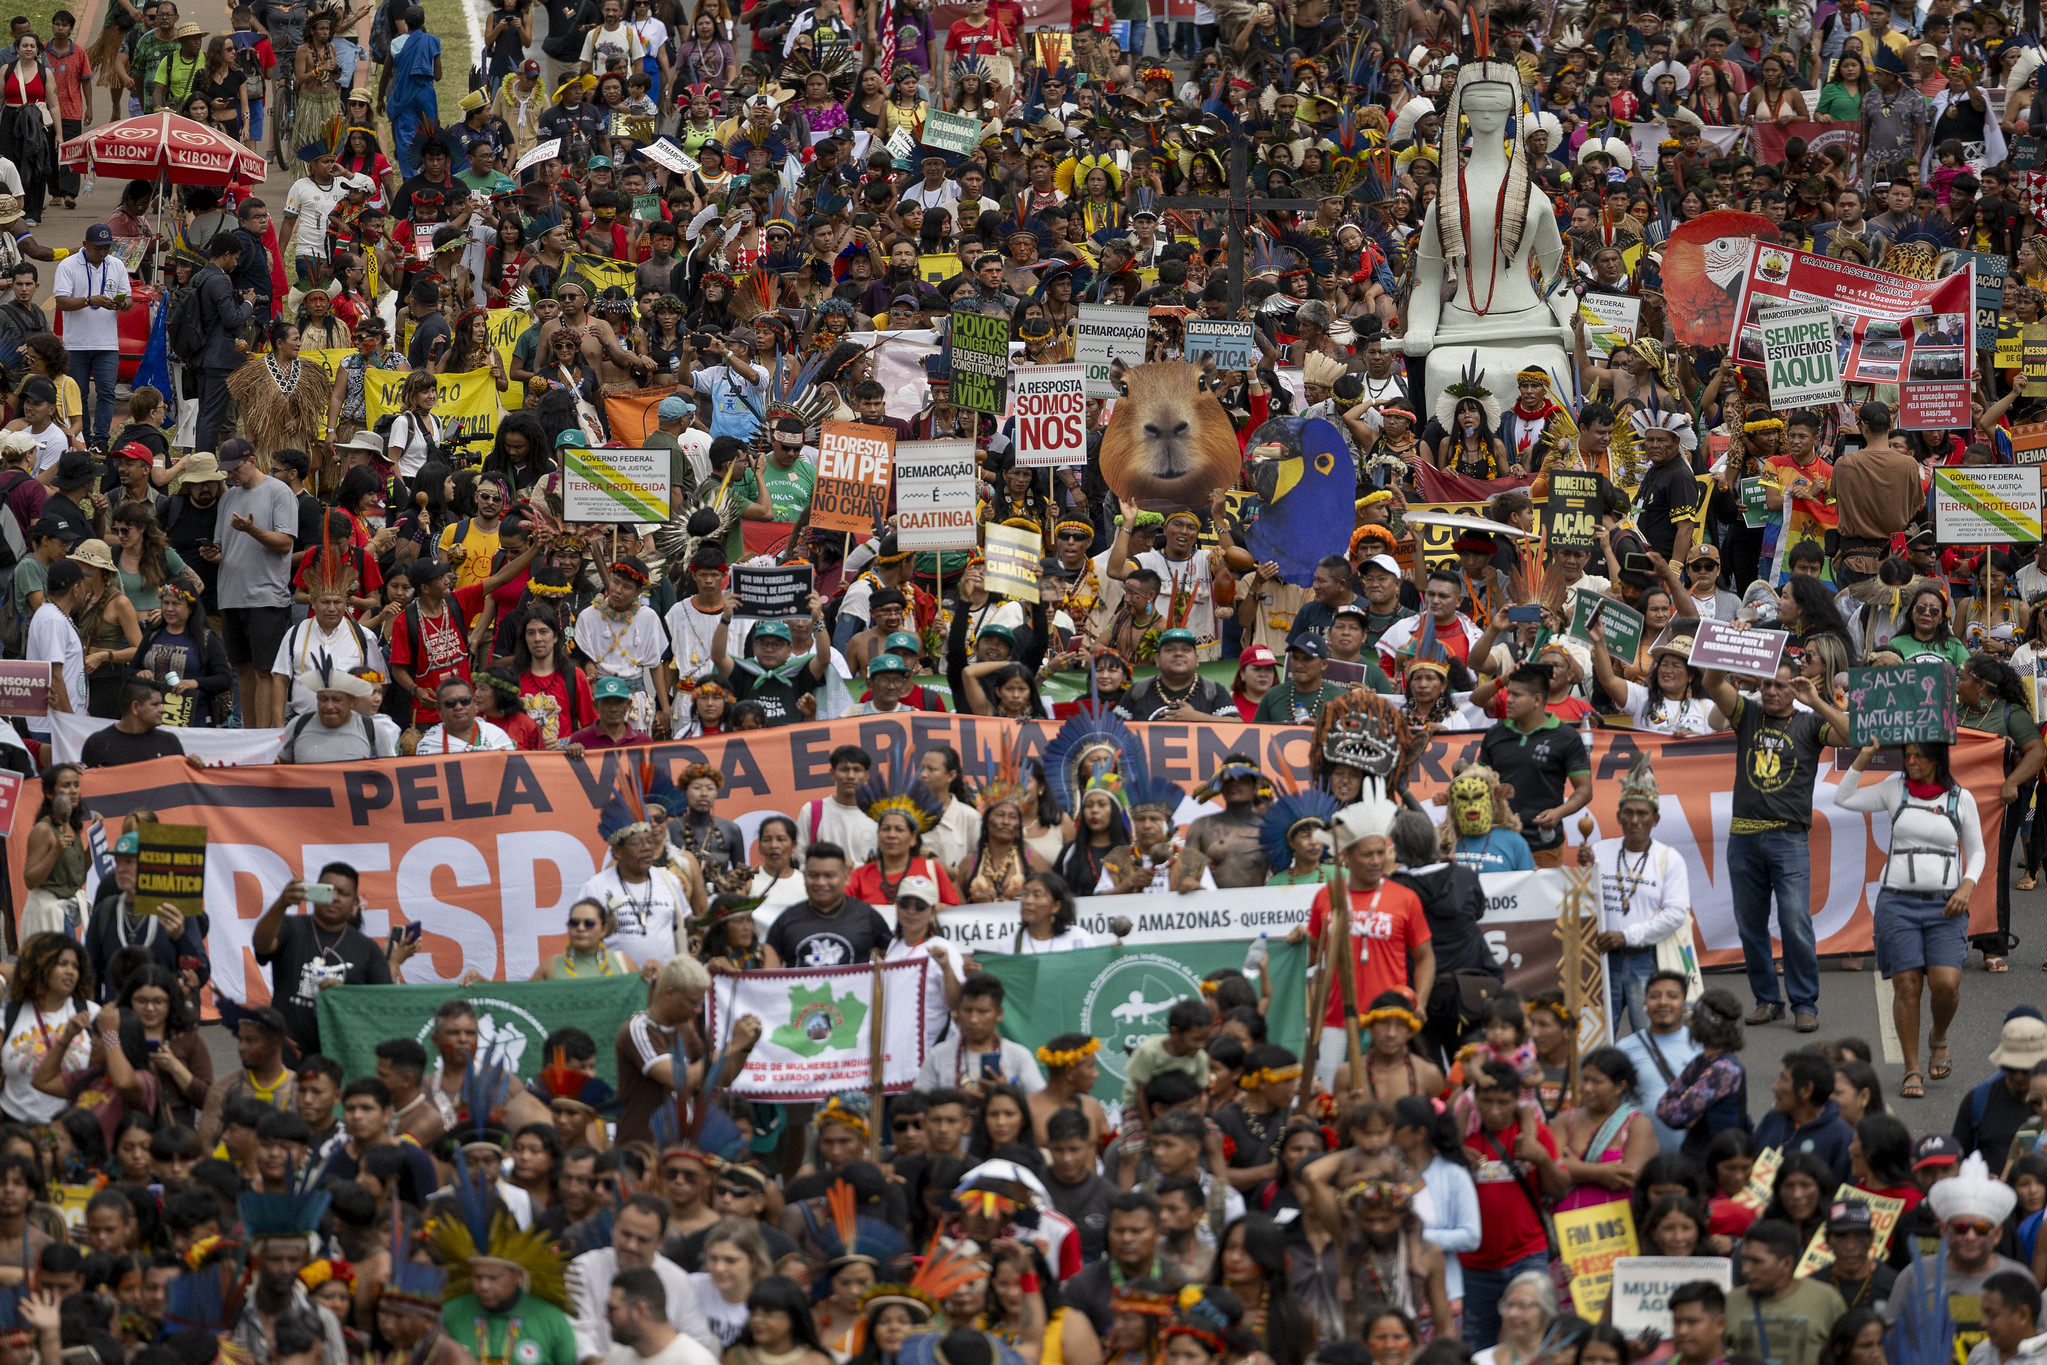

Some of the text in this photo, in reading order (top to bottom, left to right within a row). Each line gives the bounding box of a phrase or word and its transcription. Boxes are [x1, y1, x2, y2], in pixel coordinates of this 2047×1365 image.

[934, 112, 974, 128] DEFENDER
[931, 120, 974, 137] OS BIOMAS
[933, 130, 974, 145] DEFENDER
[936, 138, 962, 152] A VIDA
[105, 144, 147, 158] KIBON
[178, 150, 221, 166] KIBON
[656, 142, 700, 170] DEMARCAÇÃO
[1800, 255, 1919, 290] GRANDE ASSEMBLEIA DO
[1836, 284, 1847, 293] 08
[1856, 288, 1867, 298] 14
[1869, 291, 1910, 306] Dezembro
[1875, 284, 1912, 298] KAIOWÁ
[1596, 299, 1626, 308] FEDERAL
[1602, 308, 1623, 316] JUSTIÇA
[1760, 304, 1829, 320] #MARCOTEMPORALNÃO
[953, 313, 1008, 342] POVOS
[1079, 324, 1146, 341] DEMARCAÇÃO
[1189, 322, 1250, 337] DEMARCAÇÃO
[1765, 321, 1830, 347] SEMPRE
[1215, 336, 1221, 348] É
[1768, 340, 1832, 360] ESTIVEMOS
[952, 348, 1006, 367] EM DEFESA DA
[1106, 344, 1114, 358] É
[951, 358, 1006, 378] CONSTITUIÇÃO
[1772, 354, 1834, 389] AQUI
[966, 373, 988, 388] E DA
[1018, 379, 1082, 394] A RESPOSTA
[958, 383, 995, 411] VIDA
[1016, 392, 1084, 416] SOMOS
[1772, 390, 1840, 406] #MARCOTEMPORALNÃO
[1920, 392, 1944, 401] EDUCAÇÃO
[1920, 400, 1947, 409] EFETIVAÇÃO
[1020, 410, 1082, 451] NÓS
[823, 433, 889, 458] FLORESTA
[818, 451, 890, 485] EM PÉ
[898, 462, 973, 479] DEMARCAÇÃO
[568, 482, 666, 491] TERRA PROTEGIDA
[1554, 476, 1596, 490] DIREITOS
[932, 487, 940, 502] É
[813, 494, 837, 512] NO
[1939, 502, 2037, 511] TERRA PROTEGIDA
[900, 511, 973, 528] CAATINGA
[1552, 511, 1595, 538] AÇÃO
[1551, 536, 1594, 546] CLIMÁTICA
[987, 543, 1013, 556] ACESSO
[1015, 549, 1038, 563] DIRETO
[740, 574, 793, 584] POR UM CONSELHO
[741, 584, 768, 594] NACIONAL
[778, 582, 807, 594] EDUCAÇÃO
[1581, 596, 1640, 629] POR NACIONAL
[1614, 621, 1634, 636] ESCOLAR
[1710, 625, 1724, 634] POR
[1715, 634, 1757, 647] QUE RESPEITE
[1702, 641, 1774, 659] DIVERSIDADE CULTURAL!
[1862, 668, 1917, 690] SALVE
[4, 687, 31, 697] VIDA
[1886, 691, 1896, 707] A
[1857, 708, 1940, 729] NATUREZA
[1857, 725, 1940, 744] URGENTE
[344, 754, 553, 826] PELA
[789, 726, 838, 791] E
[859, 717, 1057, 779] PELA
[139, 851, 204, 865] ACESSO DIRETO
[138, 871, 203, 892] CLIMÁTICO
[1138, 910, 1231, 932] AMAZONAS
[1241, 909, 1311, 927] QUEREMOS
[956, 922, 982, 945] IÇÁ
[986, 923, 994, 939] E
[1140, 953, 1180, 968] Indígenas
[770, 1062, 782, 1071] DE
[786, 1061, 838, 1070] MULHERES
[753, 1072, 826, 1082] DO ESTADO DO
[1566, 1224, 1592, 1247] FIM
[1596, 1217, 1626, 1240] DOS
